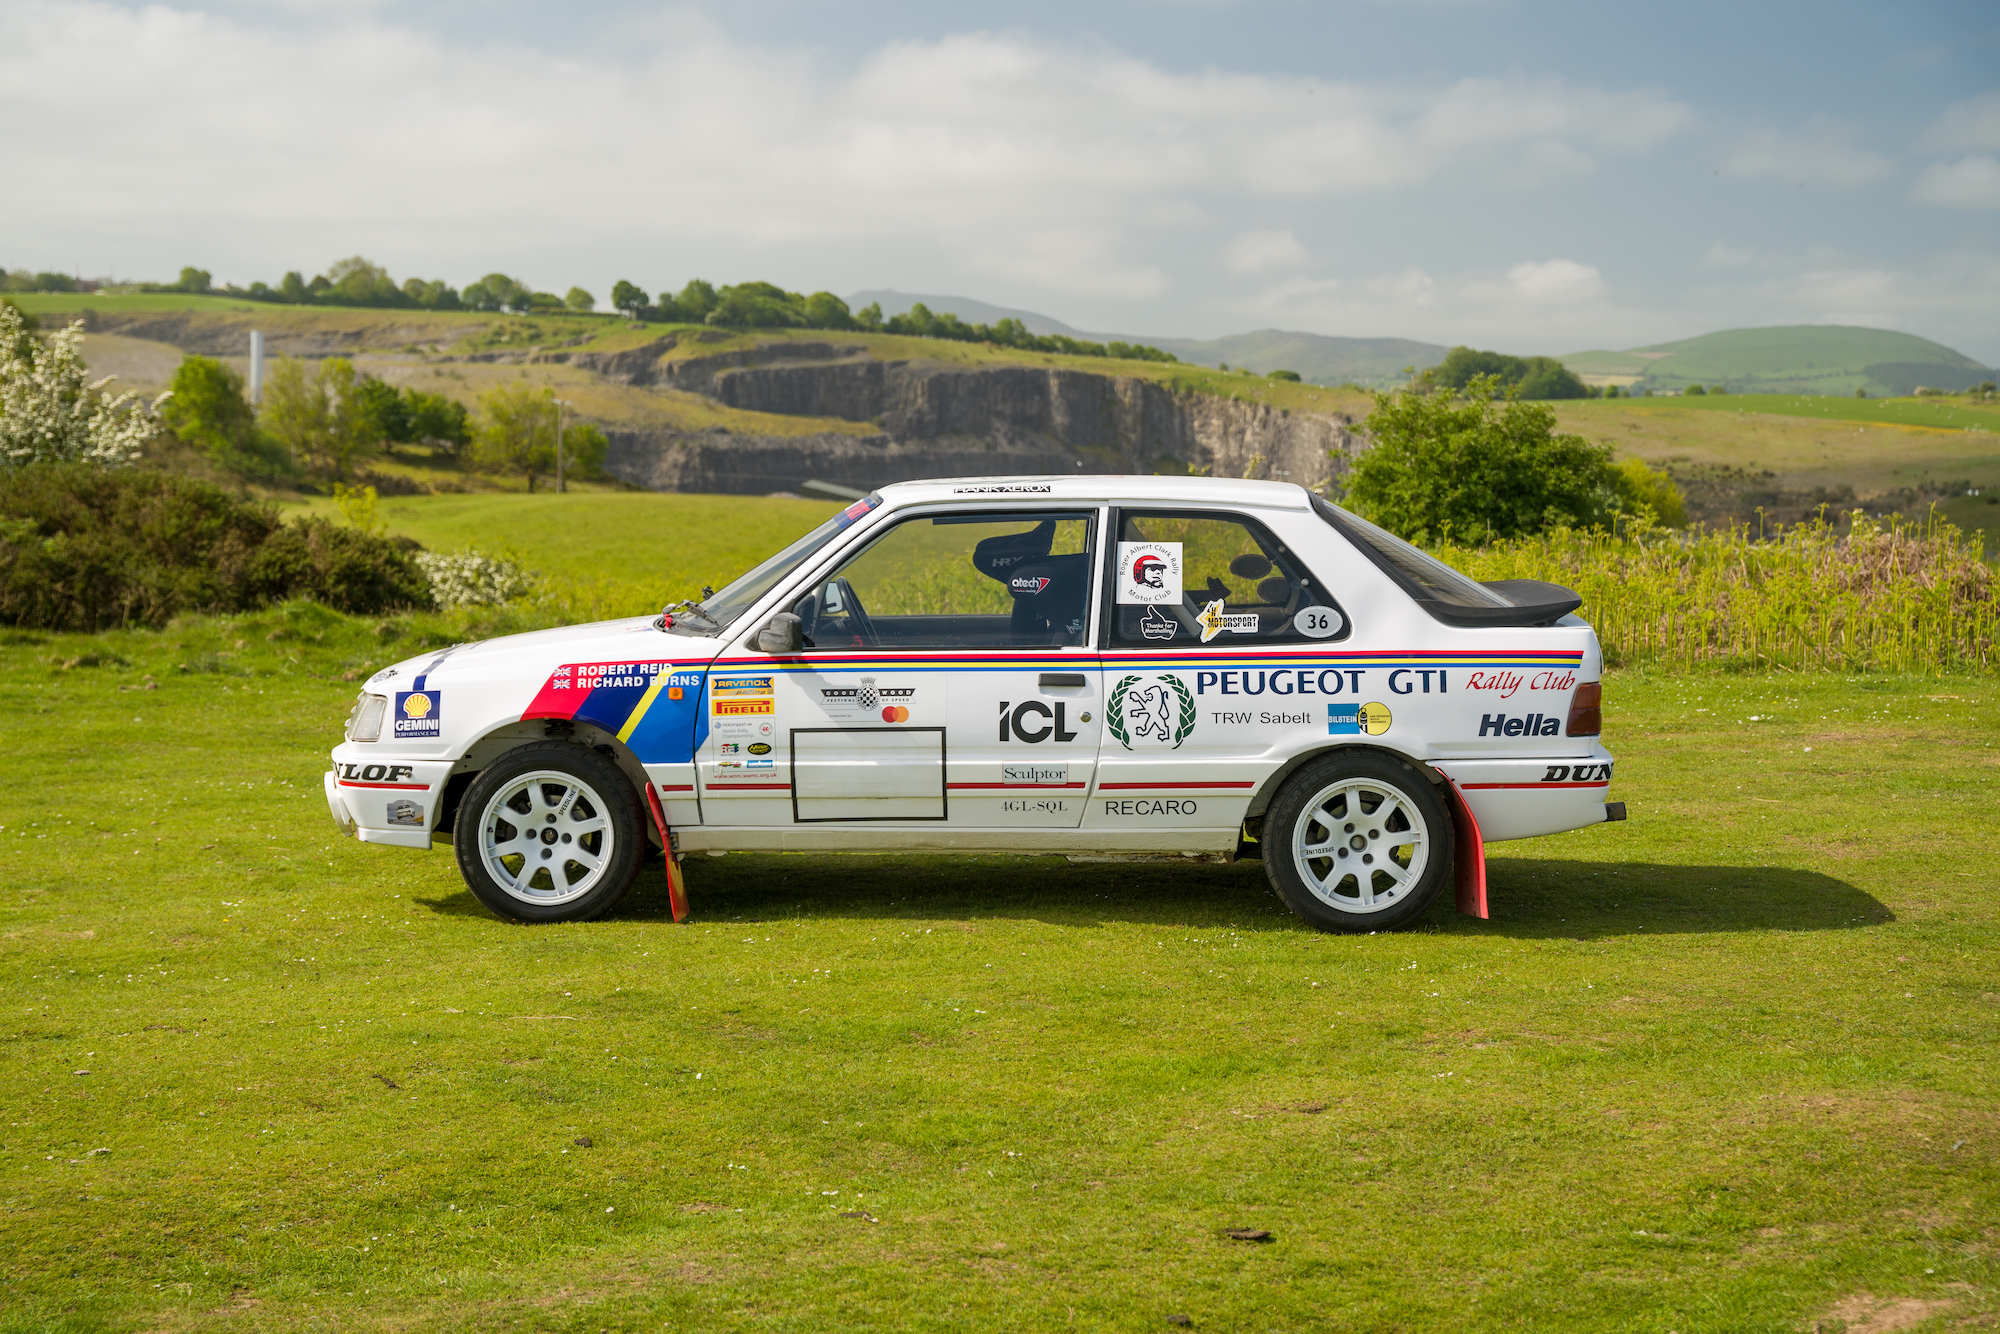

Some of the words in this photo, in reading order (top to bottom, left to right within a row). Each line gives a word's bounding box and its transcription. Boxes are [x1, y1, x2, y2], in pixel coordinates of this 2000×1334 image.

[1120, 554, 1130, 576] Roger
[1130, 544, 1152, 556] Albert
[1154, 544, 1172, 558] Clark
[1170, 557, 1180, 576] Rally
[1012, 577, 1039, 588] atech
[1128, 589, 1152, 602] Motor
[1154, 589, 1172, 602] Club
[1208, 616, 1257, 628] MOTORSPORT
[1307, 614, 1329, 630] 36
[578, 664, 635, 676] ROBERT
[640, 663, 673, 674] REID
[577, 676, 644, 688] RICHARD
[650, 675, 700, 687] BURNS
[1197, 669, 1366, 696] PEUGEOT
[1388, 668, 1447, 695] GTI
[1465, 671, 1524, 699] Rally
[1530, 670, 1576, 691] Club
[716, 700, 771, 714] PIRELLI
[395, 718, 439, 731] GEMINI
[999, 700, 1078, 744] ICL
[1211, 712, 1252, 724] TRW
[1259, 712, 1311, 724] Sabelt
[1328, 715, 1358, 723] BILSTEIN
[1478, 713, 1561, 737] Hella
[1004, 767, 1066, 783] Sculptor
[558, 789, 577, 816] SPEEDLINE
[1001, 800, 1068, 814] 4GL-SQL
[1105, 800, 1197, 815] RECARO
[1305, 846, 1335, 855] SPEEDLINE
